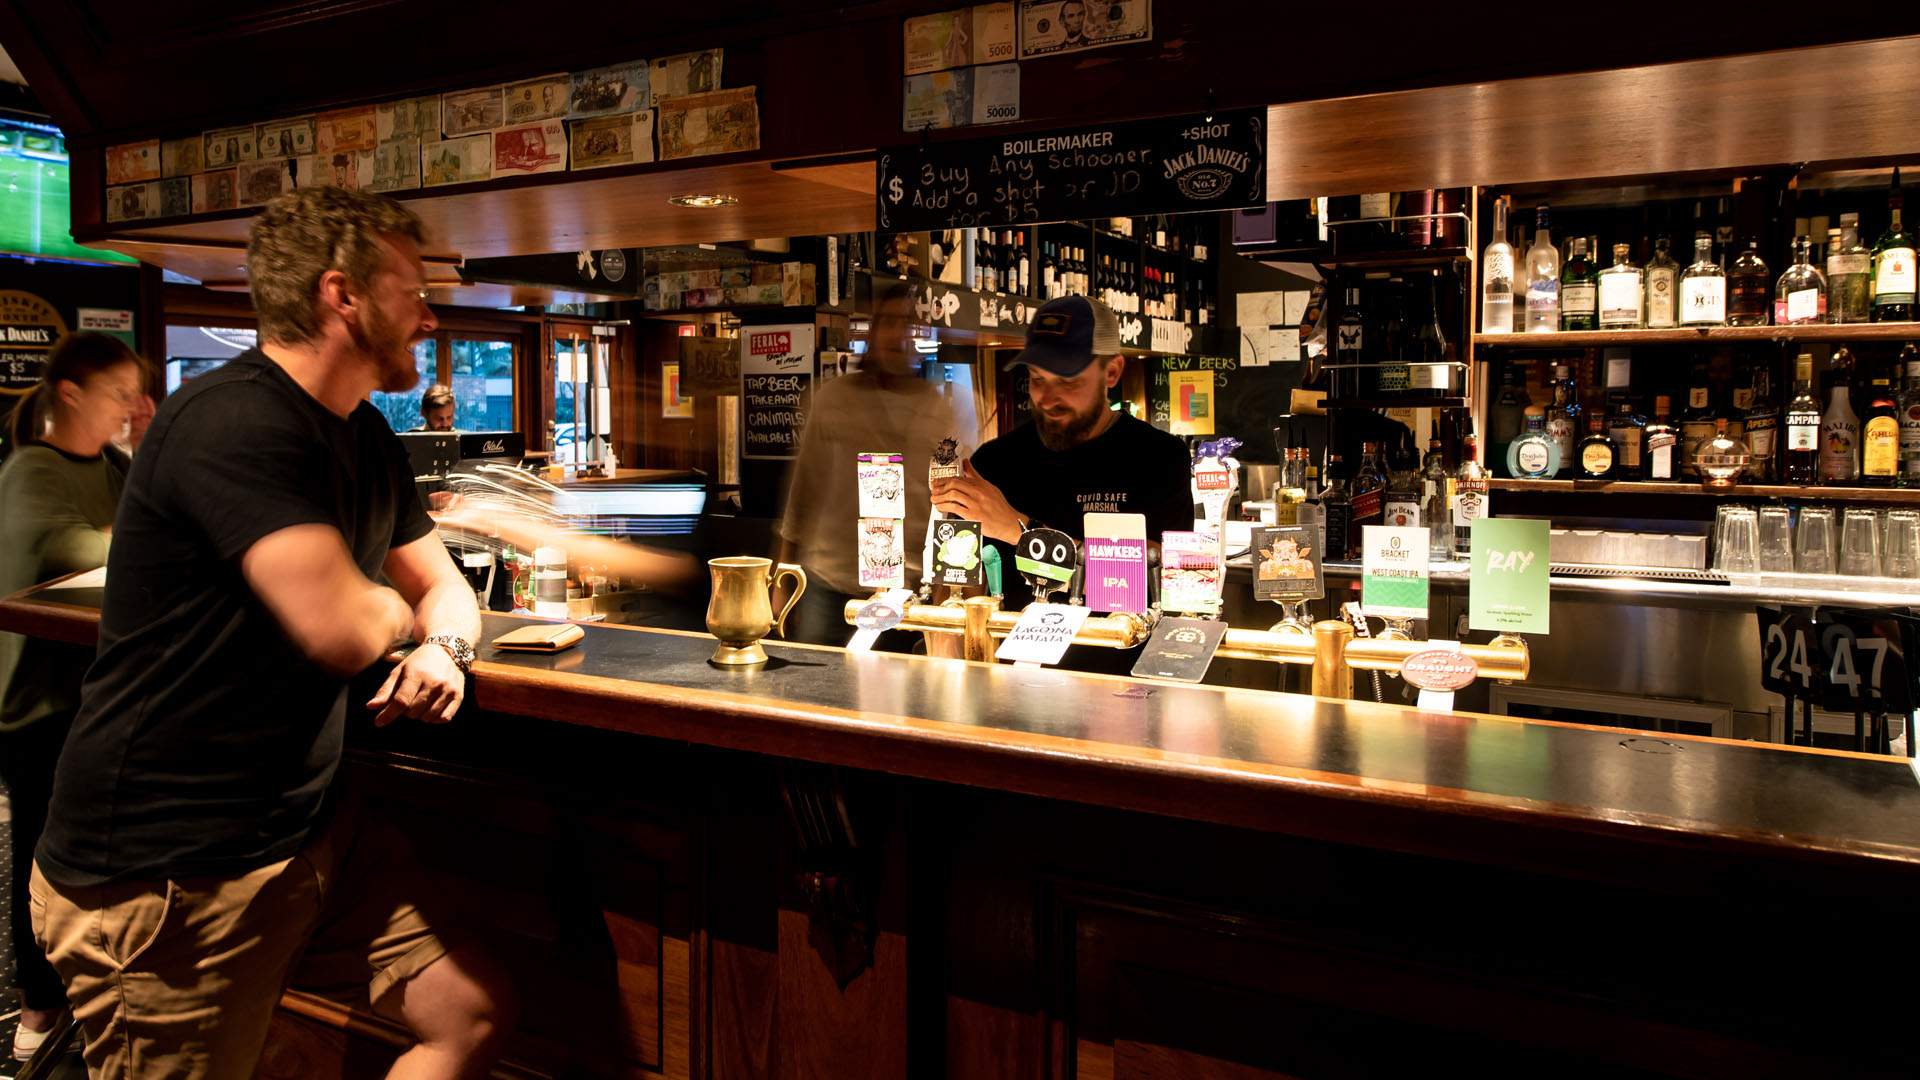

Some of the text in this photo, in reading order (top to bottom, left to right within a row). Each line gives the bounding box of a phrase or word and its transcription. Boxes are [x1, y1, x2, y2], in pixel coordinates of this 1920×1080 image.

[988, 45, 1013, 58] 5000
[986, 106, 1017, 119] 50000
[1003, 132, 1113, 157] BOILERMAKER
[1162, 152, 1195, 180] JACK
[920, 162, 970, 195] Buy
[989, 154, 1034, 181] Any
[912, 188, 950, 210] Add
[965, 192, 978, 206] a
[994, 180, 1046, 202] shot
[752, 335, 779, 349] FERAL
[1162, 357, 1237, 372] NEW BEERS
[745, 375, 806, 392] TAP BEER
[746, 393, 801, 406] TAKEAWAY
[748, 411, 806, 427] CANIMALS
[1786, 414, 1821, 425] CAMPARI
[747, 431, 791, 443] AVAILABLE
[1456, 479, 1487, 490] SMIRNOFF
[1077, 493, 1127, 503] COVID SAFE
[1082, 502, 1120, 513] MARSHAL
[1387, 508, 1398, 517] JIM
[1089, 544, 1143, 559] HAWKERS
[1381, 549, 1410, 559] BRACKET
[1372, 568, 1419, 579] WEST COAST IPA
[1103, 577, 1128, 588] IPA
[1405, 663, 1473, 673] DRAUGHT
